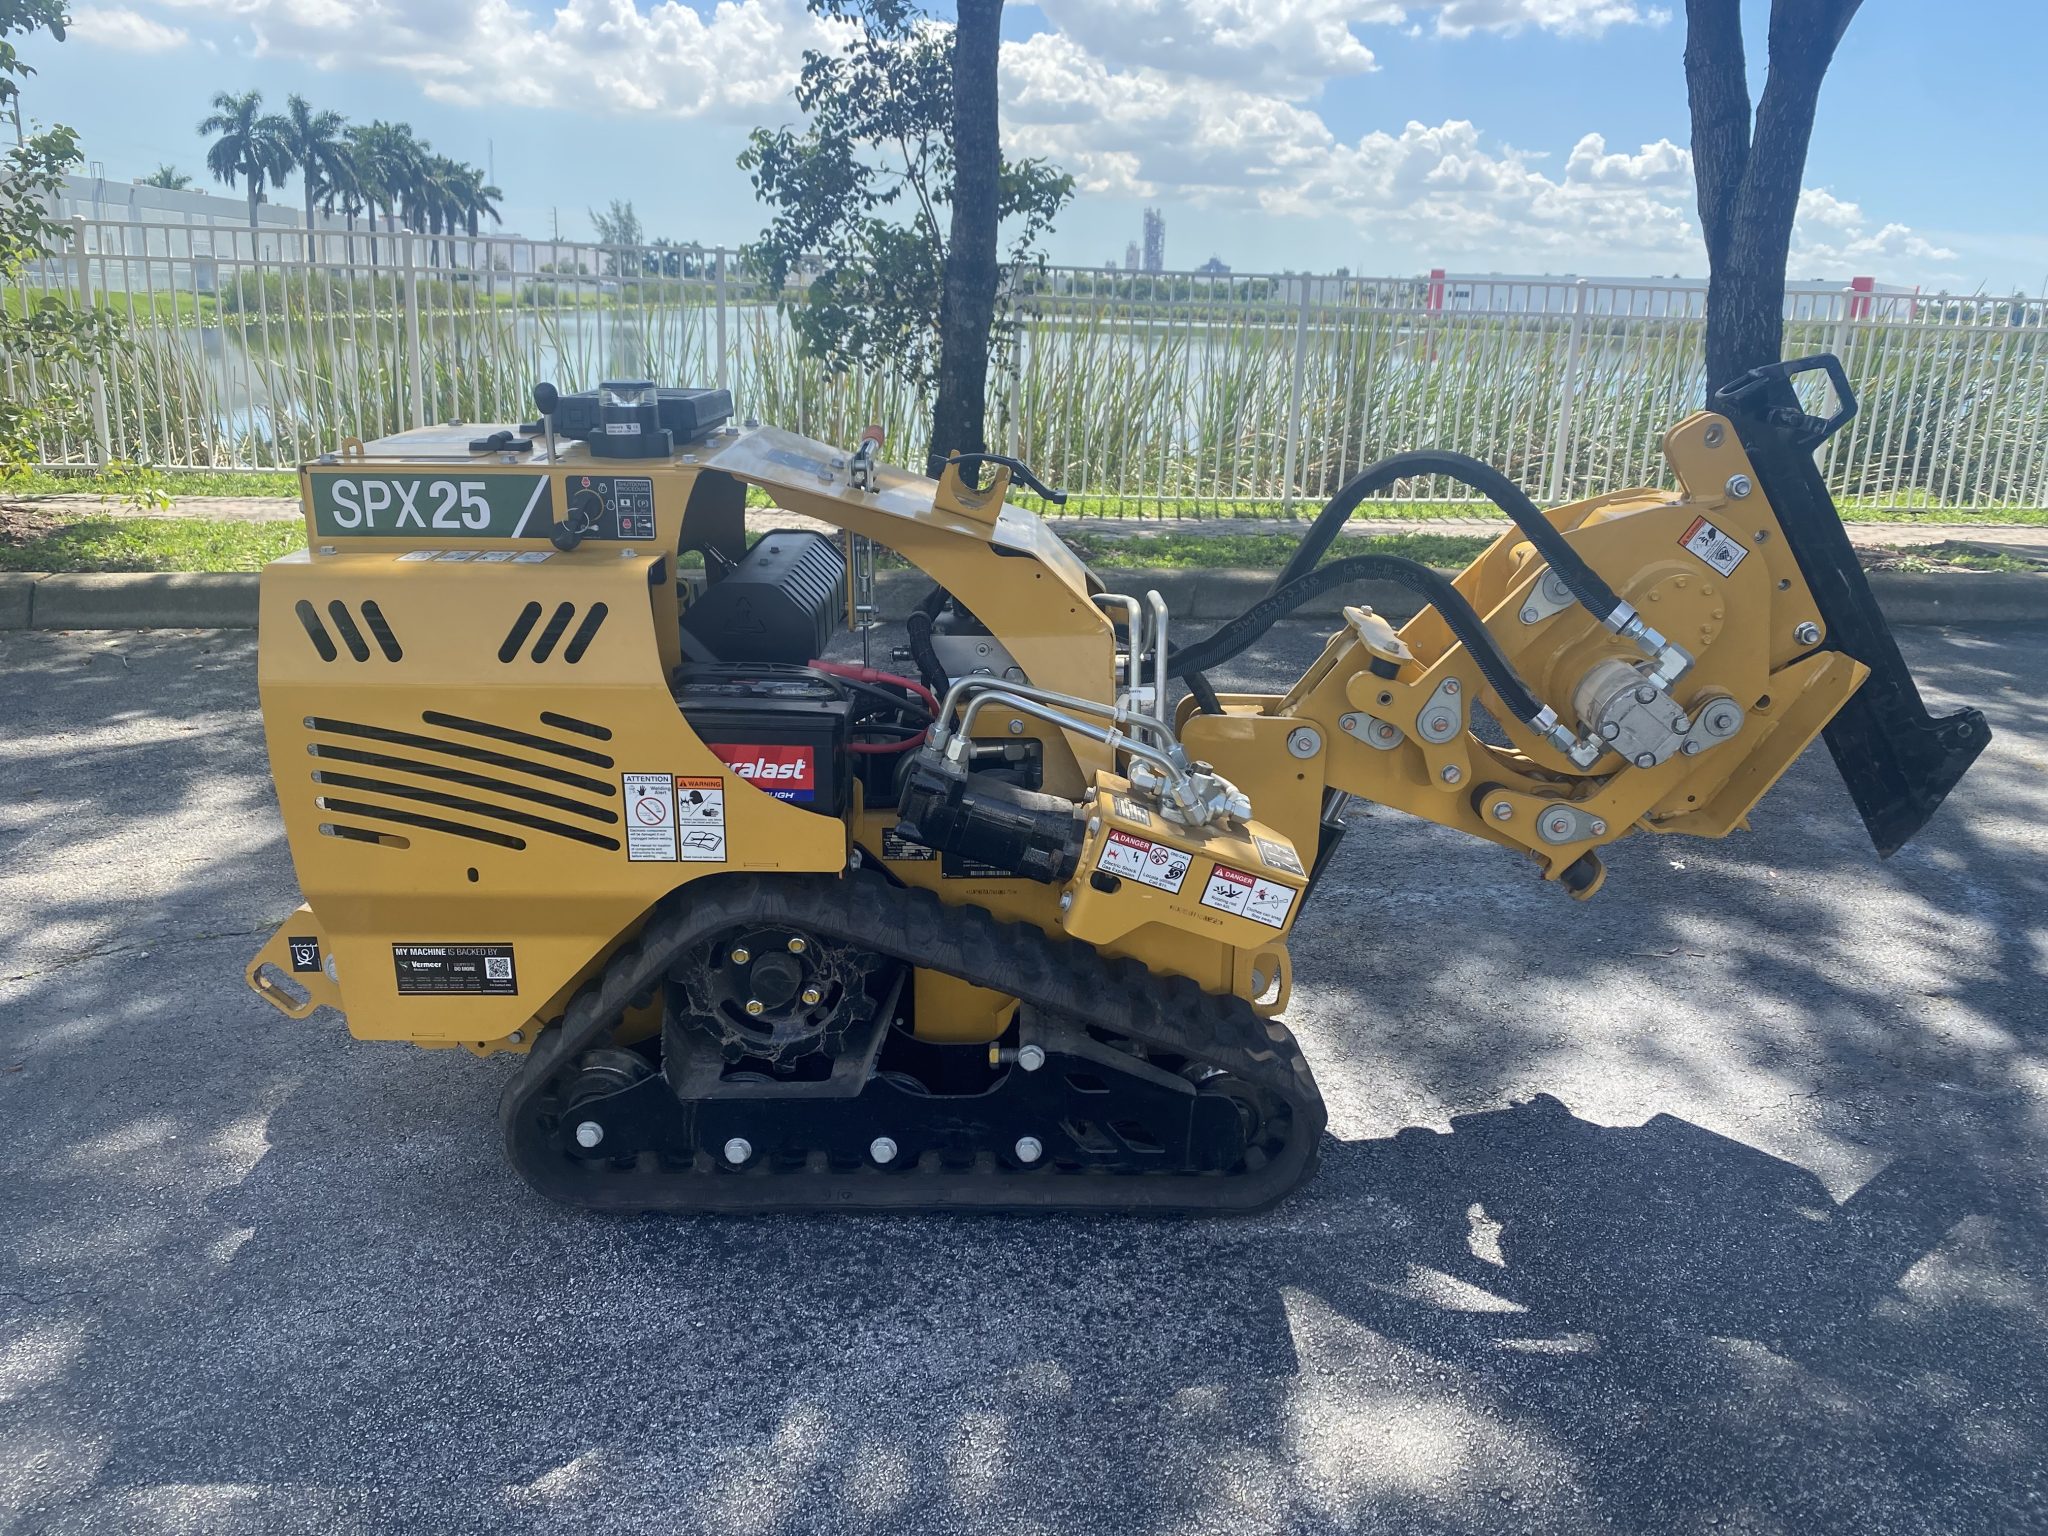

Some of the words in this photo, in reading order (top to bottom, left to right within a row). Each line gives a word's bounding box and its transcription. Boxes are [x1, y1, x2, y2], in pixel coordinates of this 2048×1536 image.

[332, 479, 491, 529] SPX25
[723, 758, 806, 780] ralast
[1119, 835, 1150, 850] DANGER
[1103, 859, 1121, 869] Electric
[1121, 865, 1137, 874] Shock
[1224, 872, 1253, 885] DANGER
[395, 948, 408, 956] MY
[410, 948, 447, 956] MACHINE
[447, 948, 455, 956] IS
[456, 948, 486, 956] BACKED
[487, 948, 498, 956] BY
